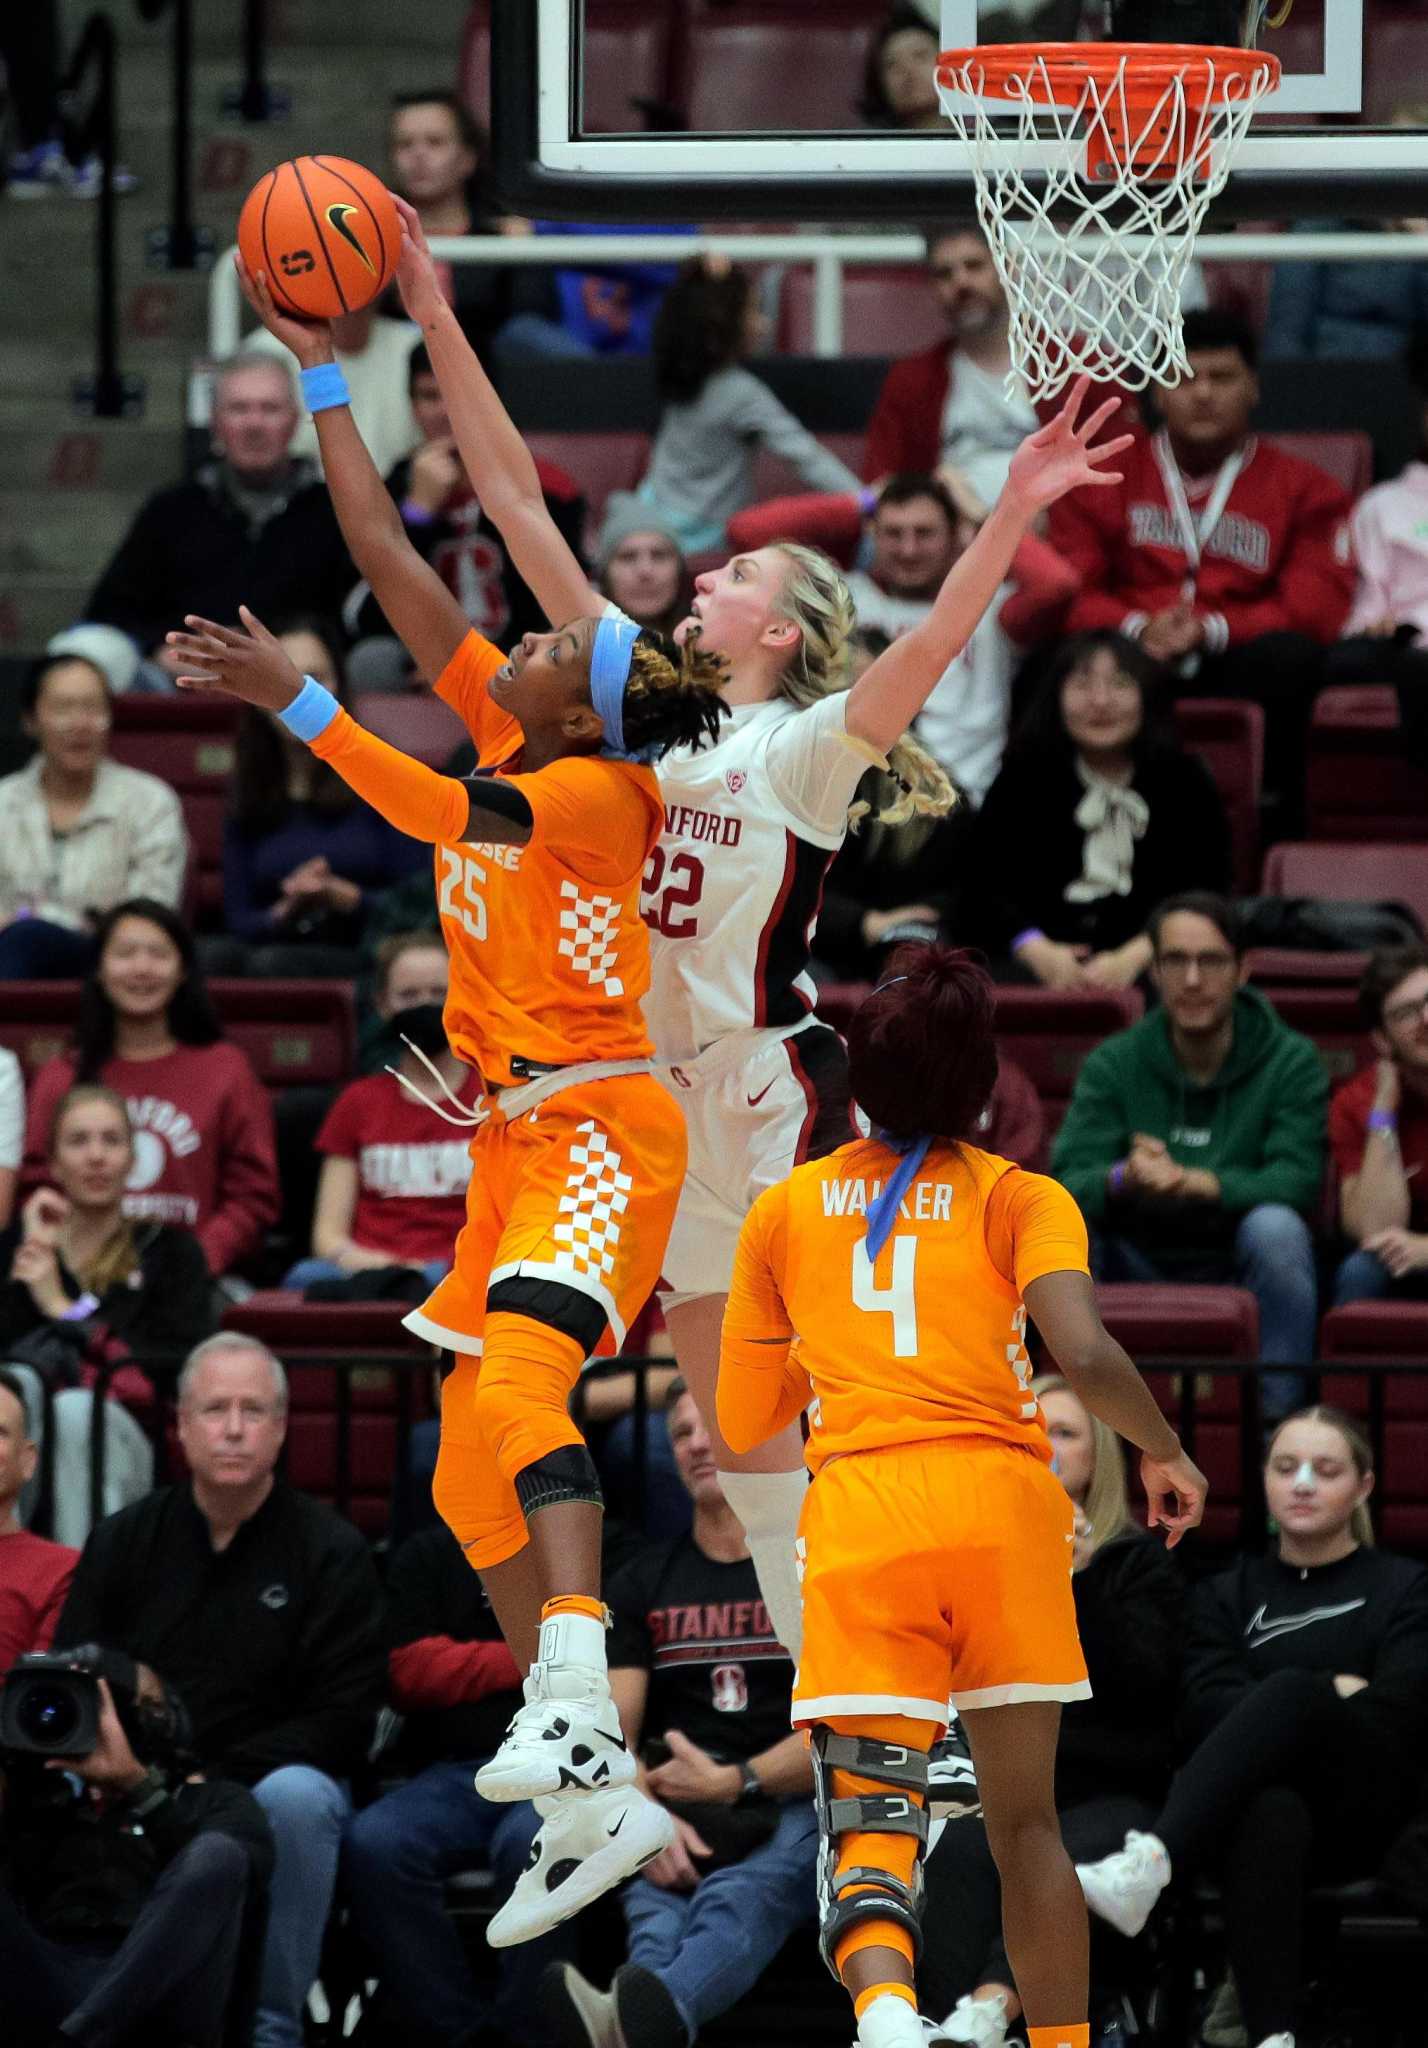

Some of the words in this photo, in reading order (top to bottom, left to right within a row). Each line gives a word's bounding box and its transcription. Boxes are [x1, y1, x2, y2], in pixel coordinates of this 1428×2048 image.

[440, 843, 488, 941] 25
[639, 845, 704, 938] 22
[852, 1235, 918, 1357] 4
